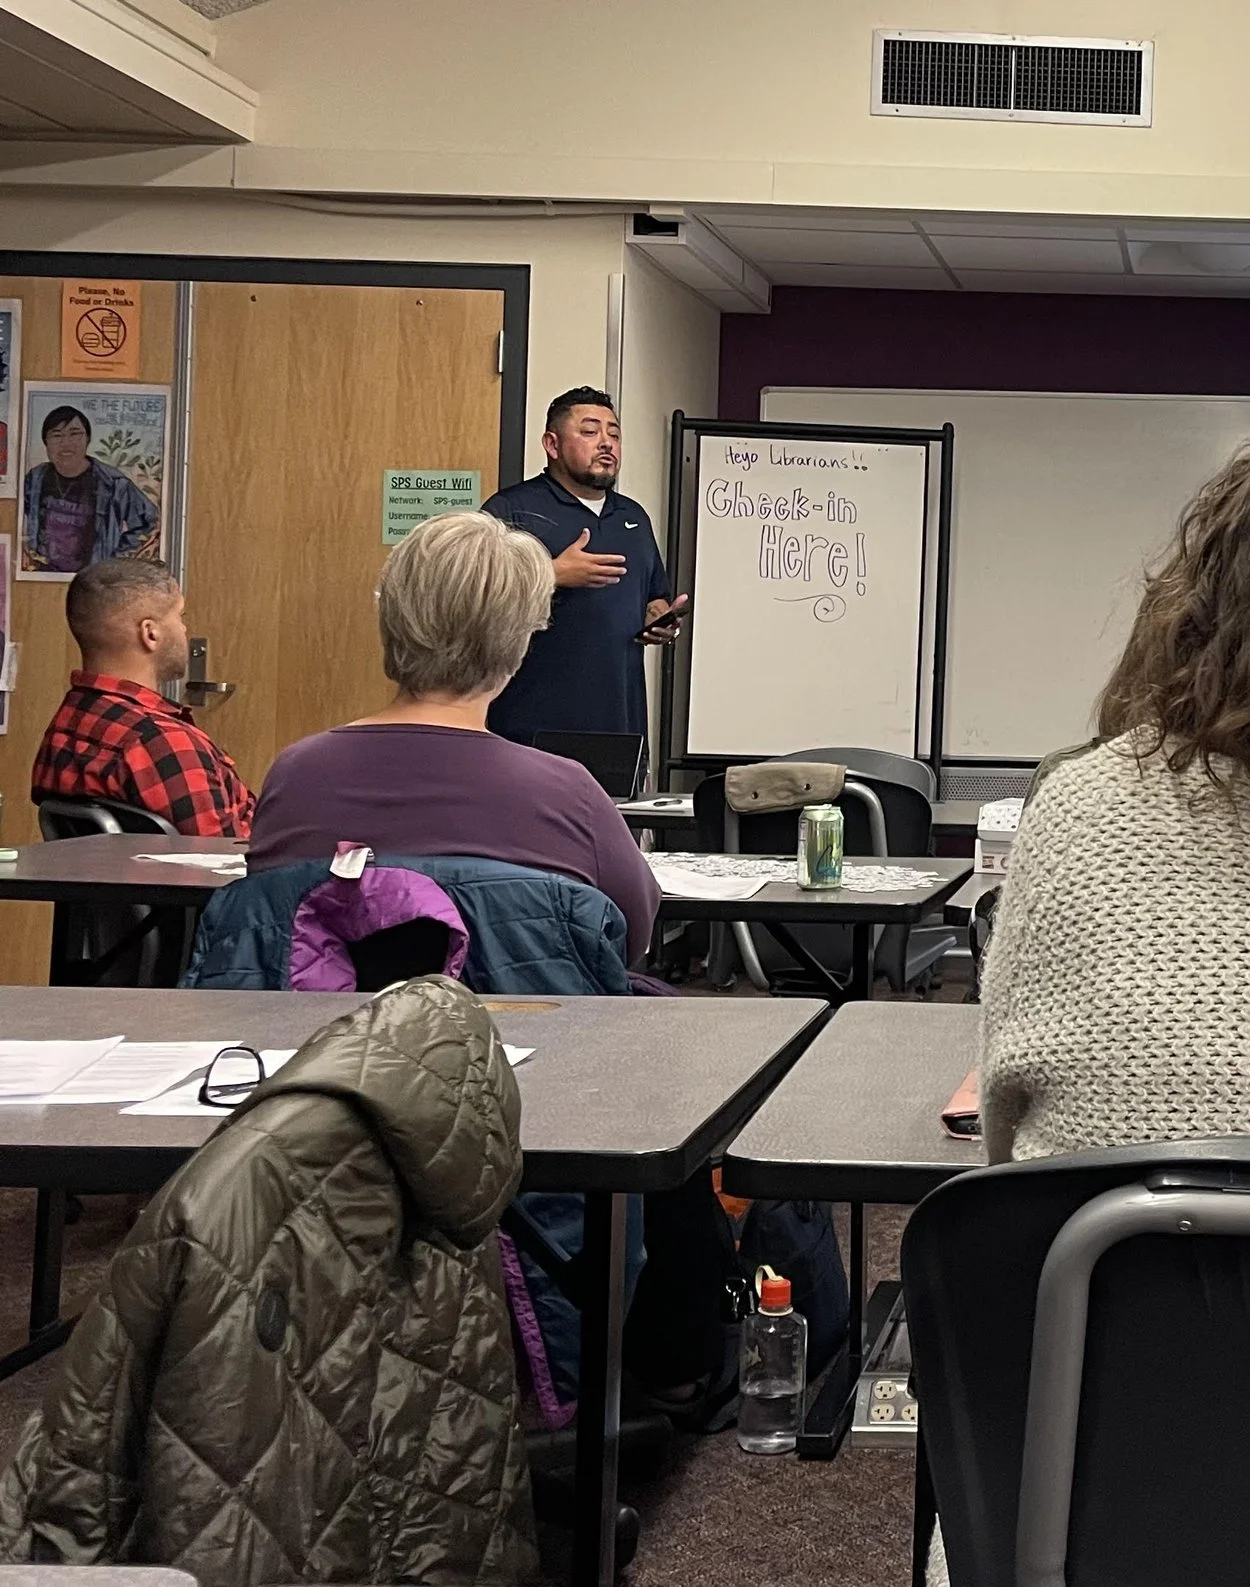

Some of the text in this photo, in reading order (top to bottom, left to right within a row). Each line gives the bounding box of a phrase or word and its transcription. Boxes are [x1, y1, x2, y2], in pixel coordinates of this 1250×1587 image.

[113, 288, 126, 296] No
[69, 296, 92, 306] Food
[104, 298, 135, 307] Drinks
[725, 445, 758, 471] Heyo
[391, 476, 472, 490] SPS Guest Wifi
[388, 496, 473, 507] Network: SPS-guest
[706, 478, 858, 524] Check-in
[759, 525, 867, 597] Here!
